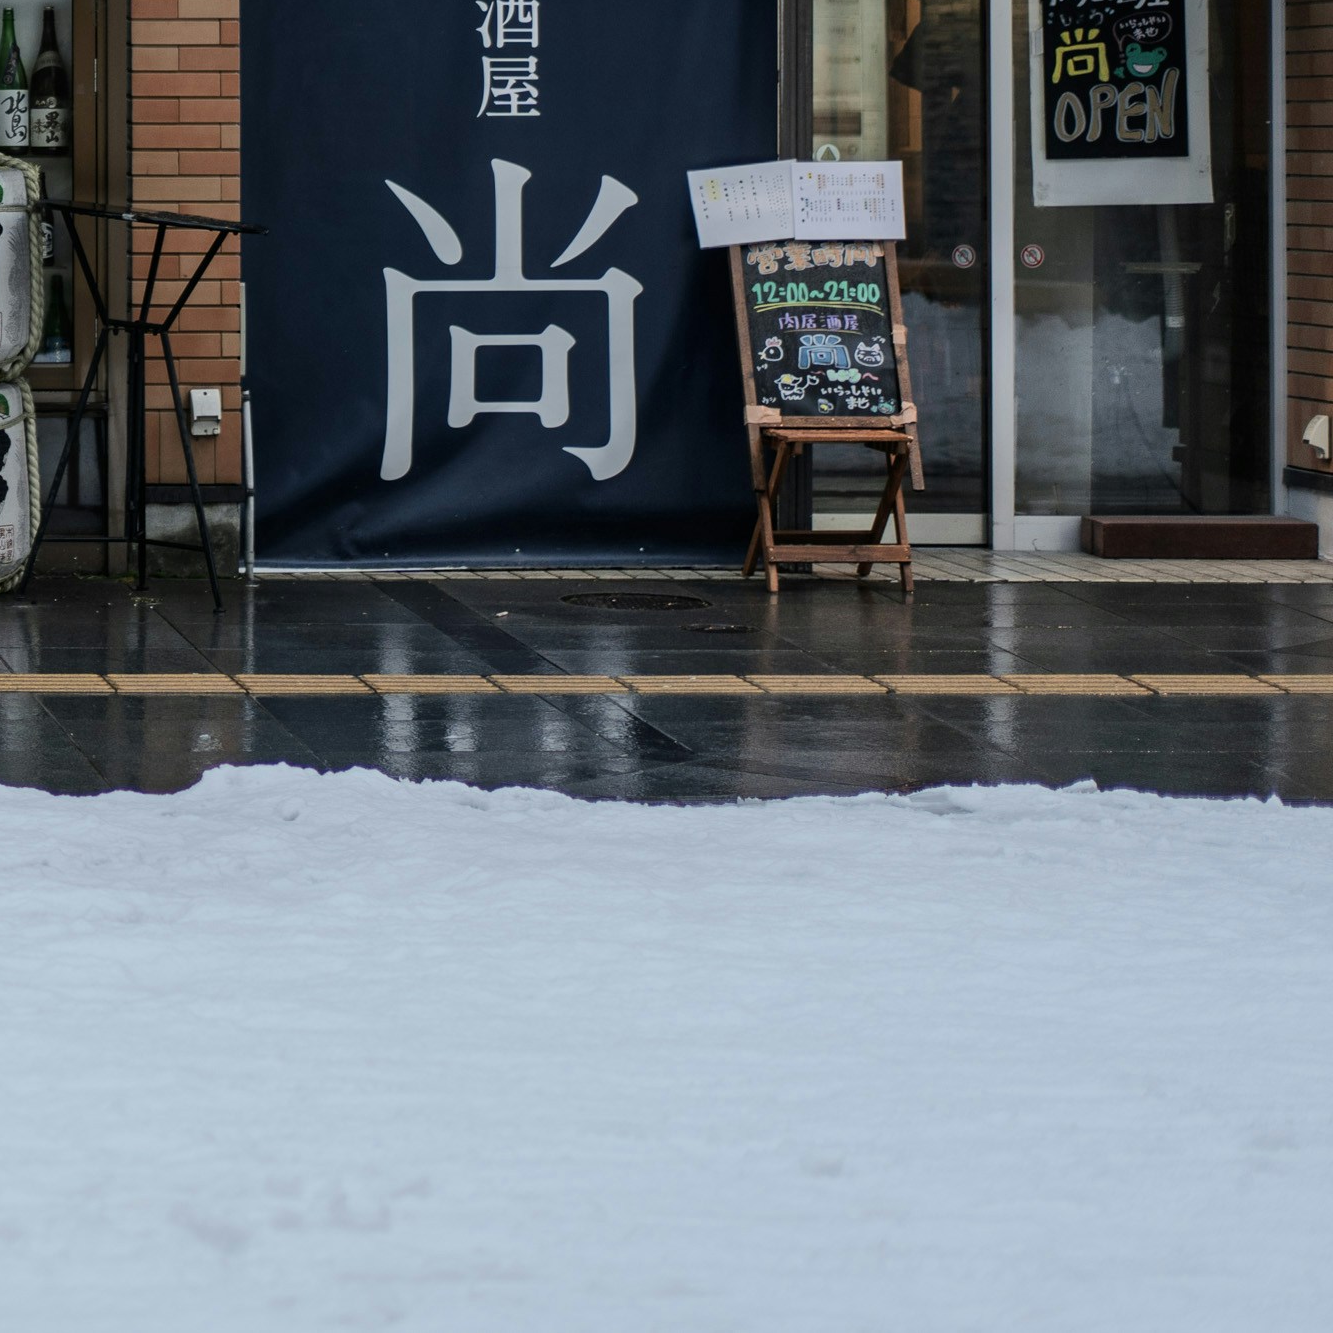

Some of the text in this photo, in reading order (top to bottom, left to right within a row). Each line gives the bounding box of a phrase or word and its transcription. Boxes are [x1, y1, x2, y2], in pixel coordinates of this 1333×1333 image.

[1052, 28, 1110, 84] 尚
[1054, 67, 1180, 143] OPEN
[747, 242, 878, 275] 営業時間
[380, 158, 644, 481] 尚
[778, 312, 859, 330] 肉居酒屋
[798, 334, 850, 369] 尚
